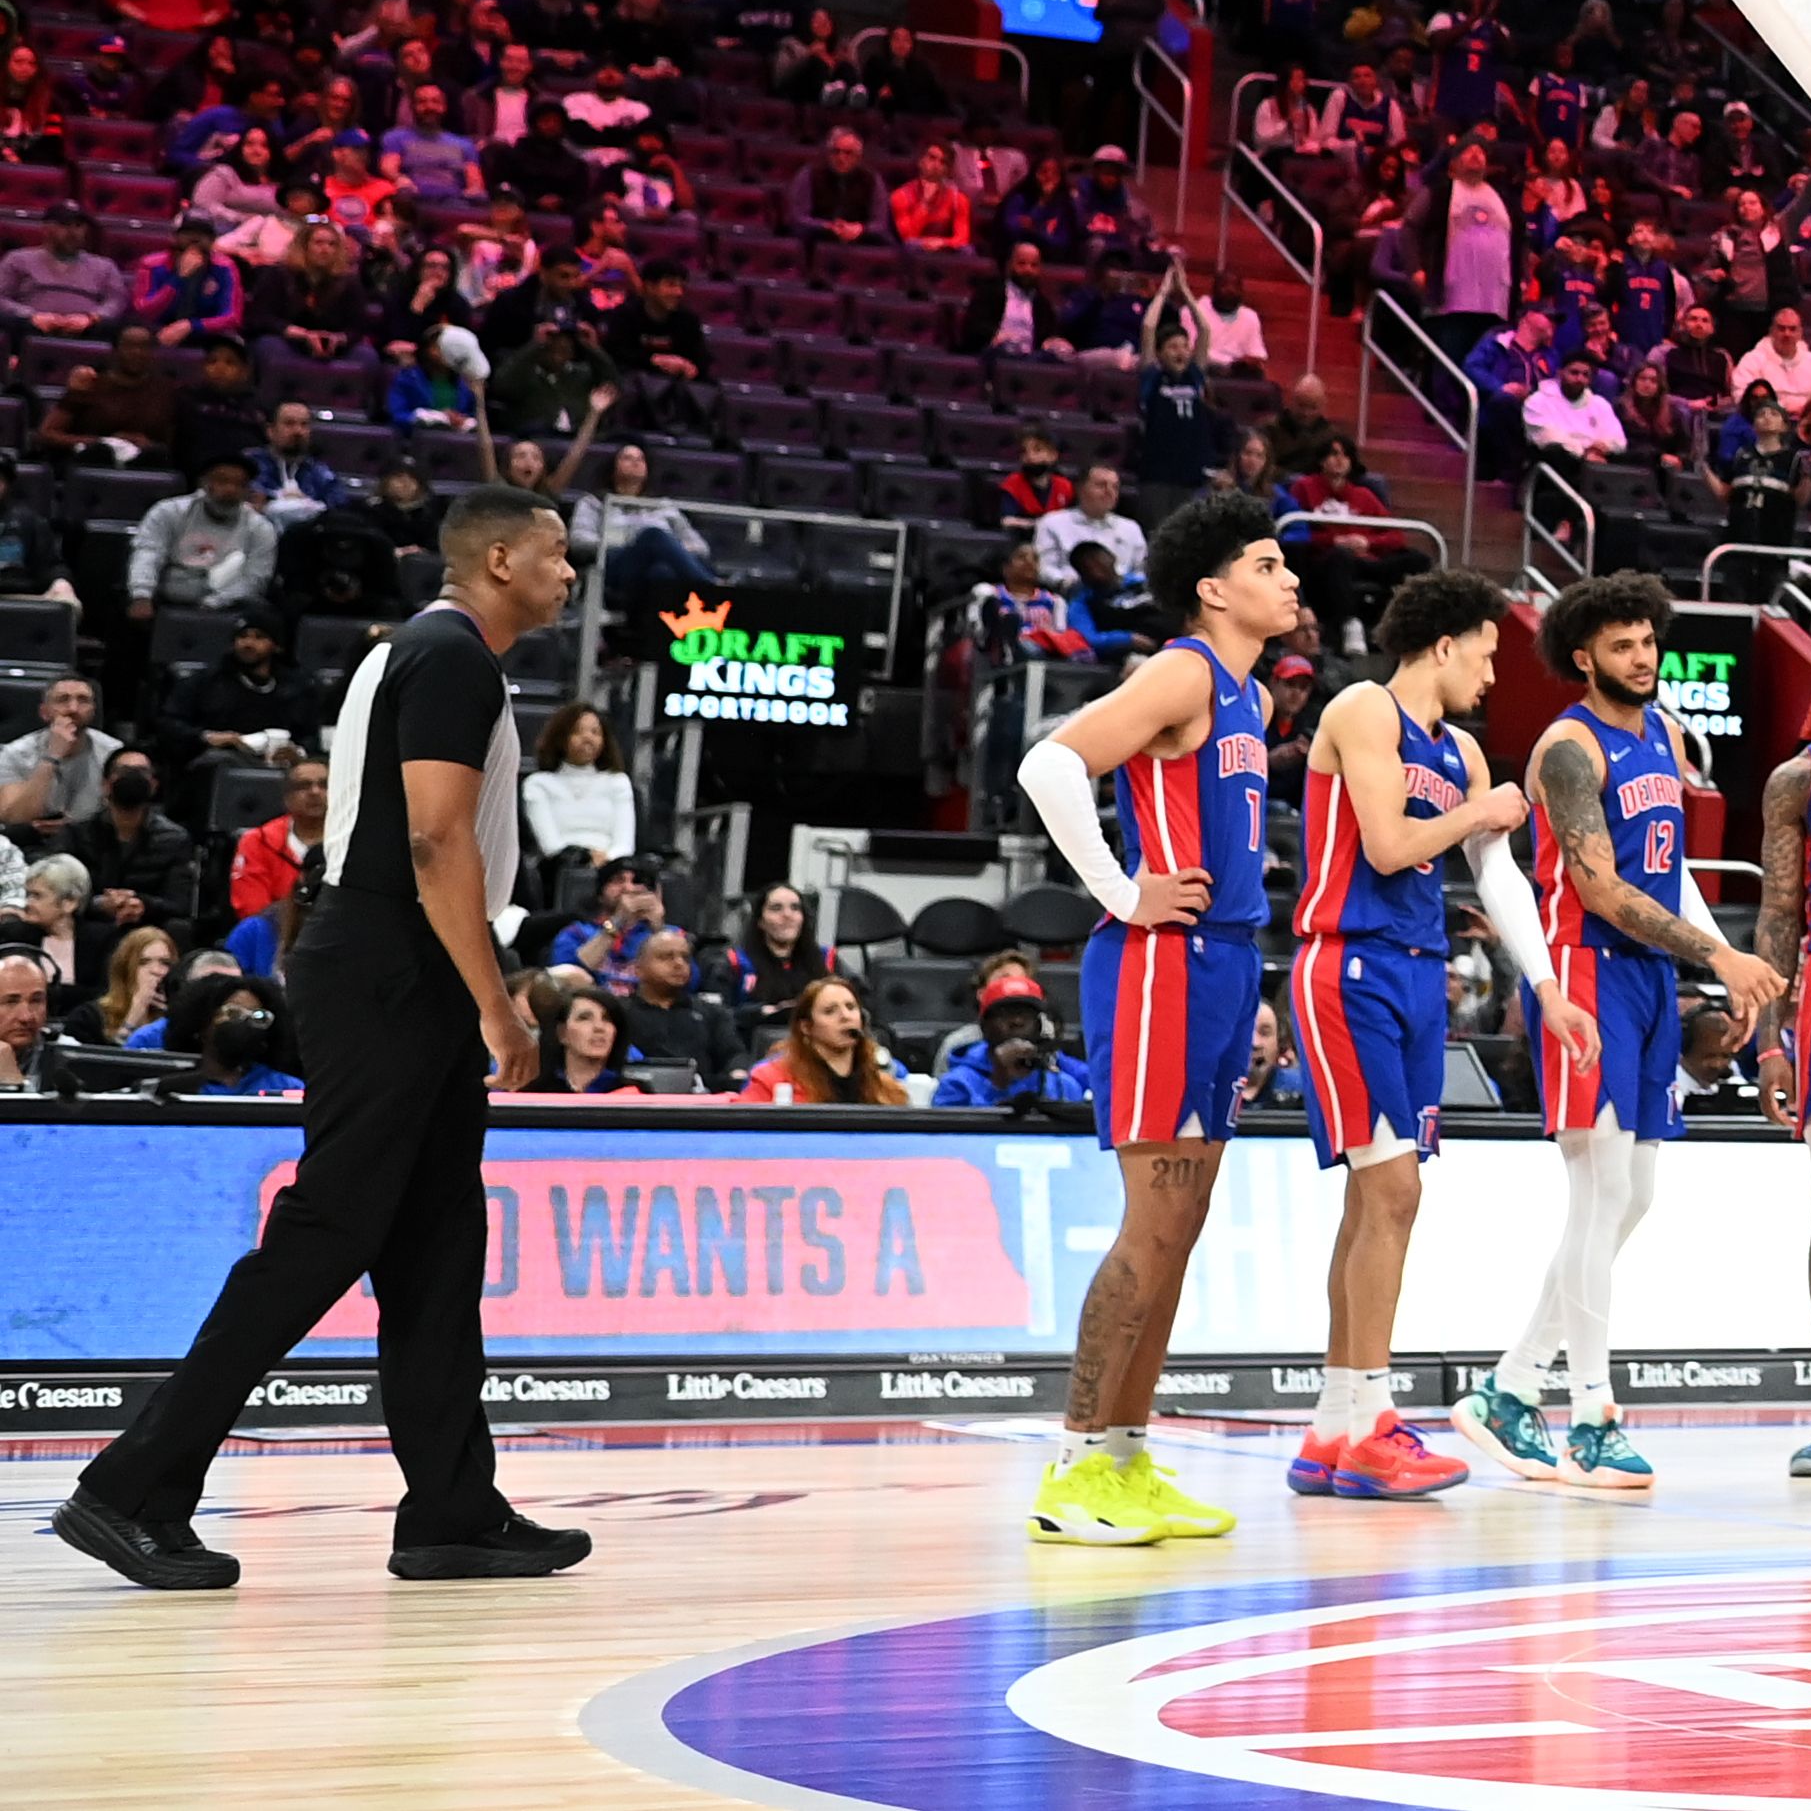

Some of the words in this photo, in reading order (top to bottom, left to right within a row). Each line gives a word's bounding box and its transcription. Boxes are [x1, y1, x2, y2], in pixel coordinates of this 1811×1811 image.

[670, 627, 845, 667] DRAFT
[688, 656, 836, 699] KINGS
[1659, 650, 1737, 682] AFT
[664, 693, 849, 726] SPORTSBOOK
[1657, 680, 1731, 712] NGS
[1245, 787, 1261, 852] 1
[1643, 820, 1674, 874] 12
[548, 1184, 847, 1299] WANTS
[874, 1185, 927, 1297] A
[513, 1375, 611, 1401] Caesars
[667, 1374, 732, 1401] Little
[733, 1373, 828, 1400] Caesars
[880, 1372, 944, 1398] Little
[944, 1371, 1034, 1398] Caesars
[1628, 1362, 1683, 1387] Little
[1683, 1361, 1762, 1387] Caesars
[18, 1382, 123, 1410] Caesars
[267, 1379, 369, 1405] Caesars
